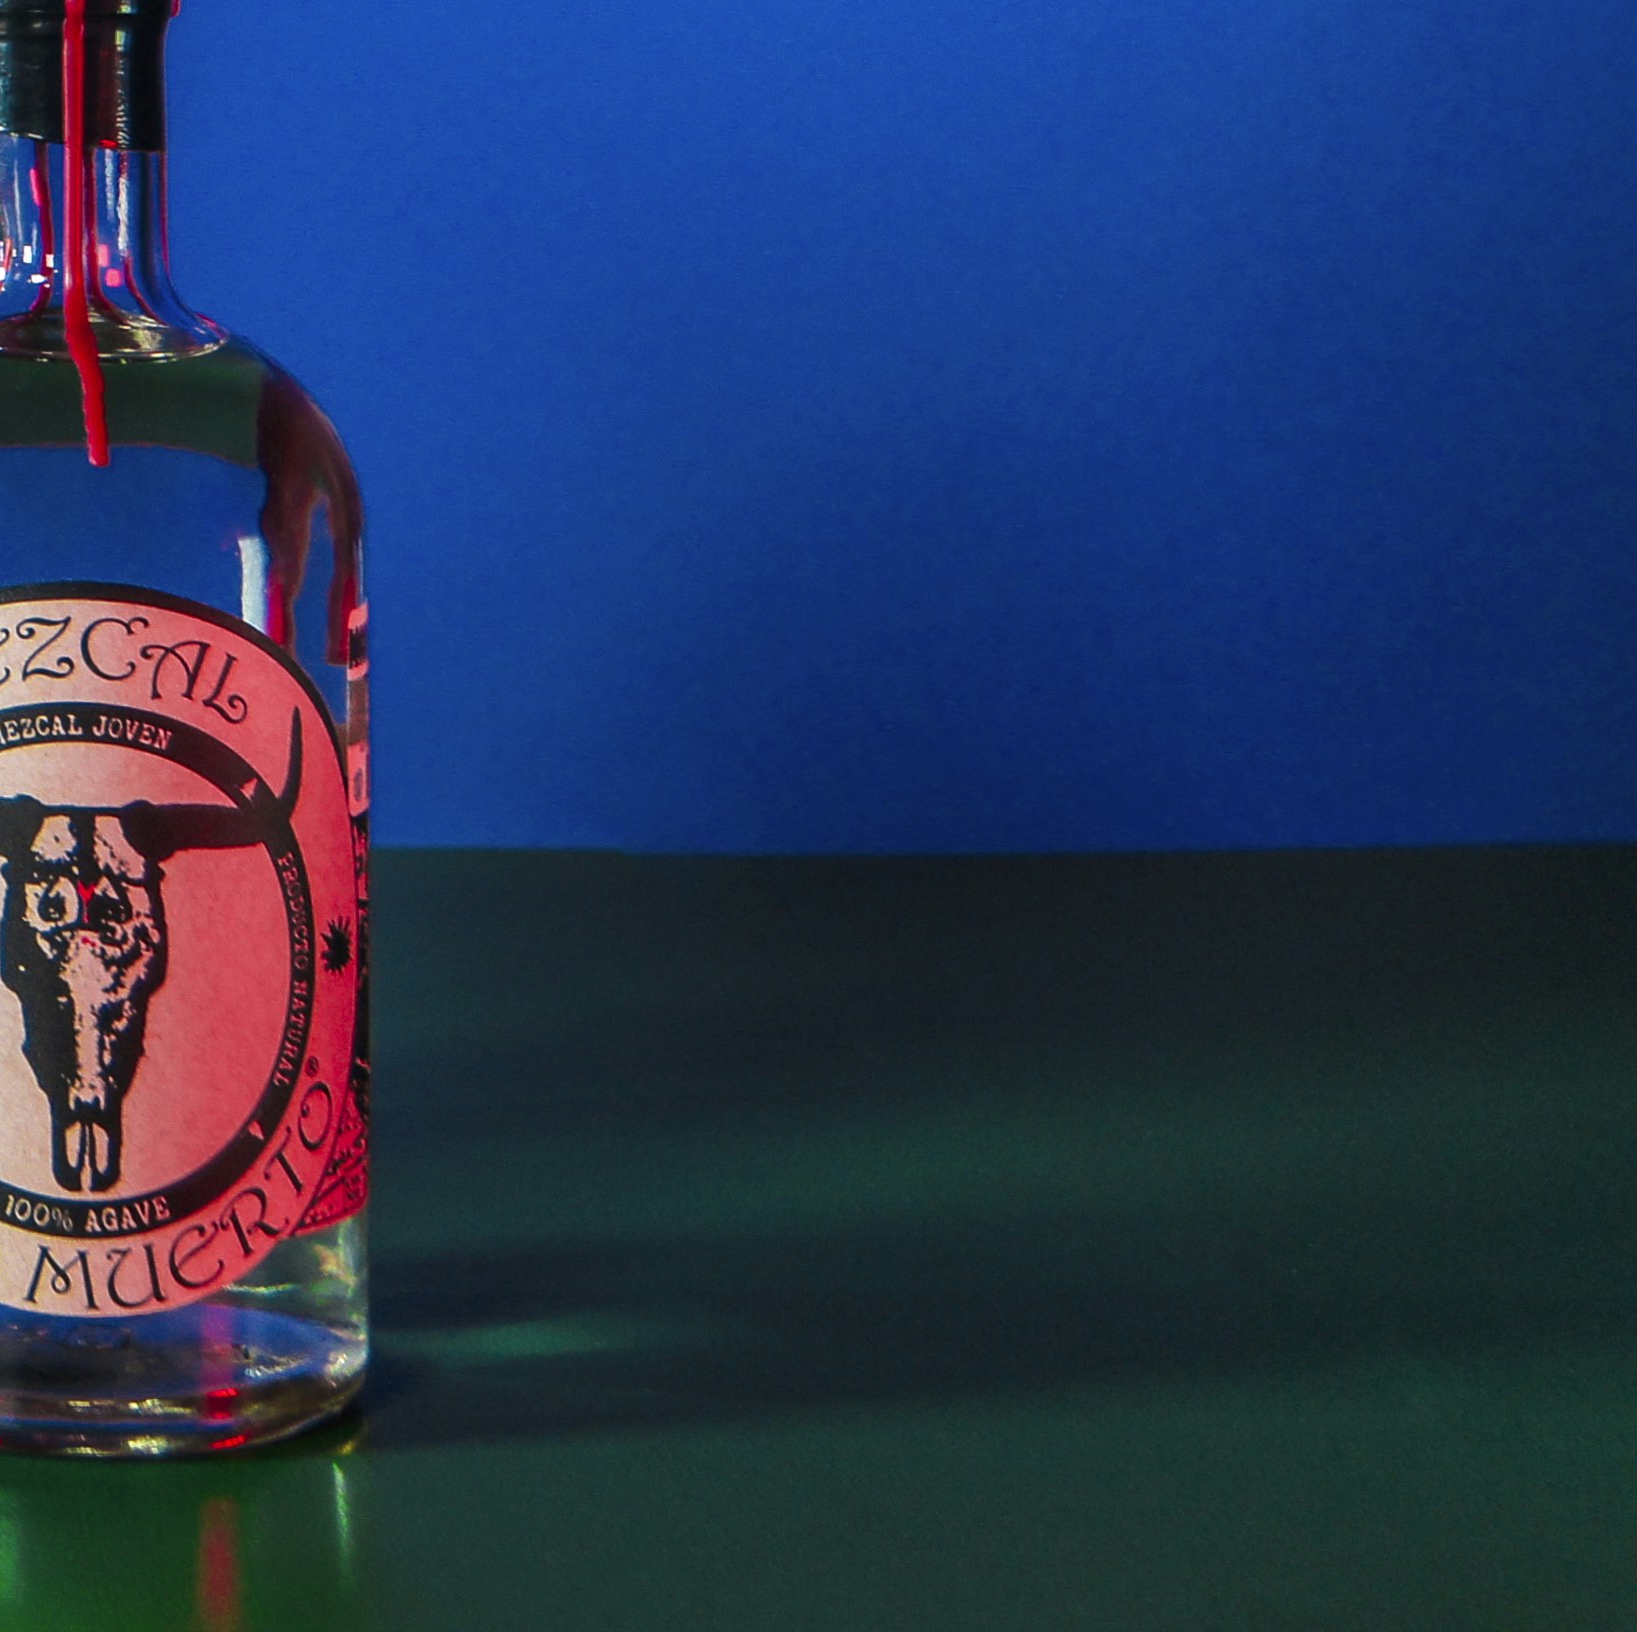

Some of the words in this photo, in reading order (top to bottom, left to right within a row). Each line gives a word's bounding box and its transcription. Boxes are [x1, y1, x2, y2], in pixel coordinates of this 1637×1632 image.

[92, 715, 175, 751] JOVEN
[277, 853, 309, 970] PRODUCTO
[274, 979, 309, 1087] NATURAL
[4, 1192, 74, 1232] 100%
[85, 1196, 171, 1233] AGAVE
[25, 1082, 334, 1312] MUERTO
